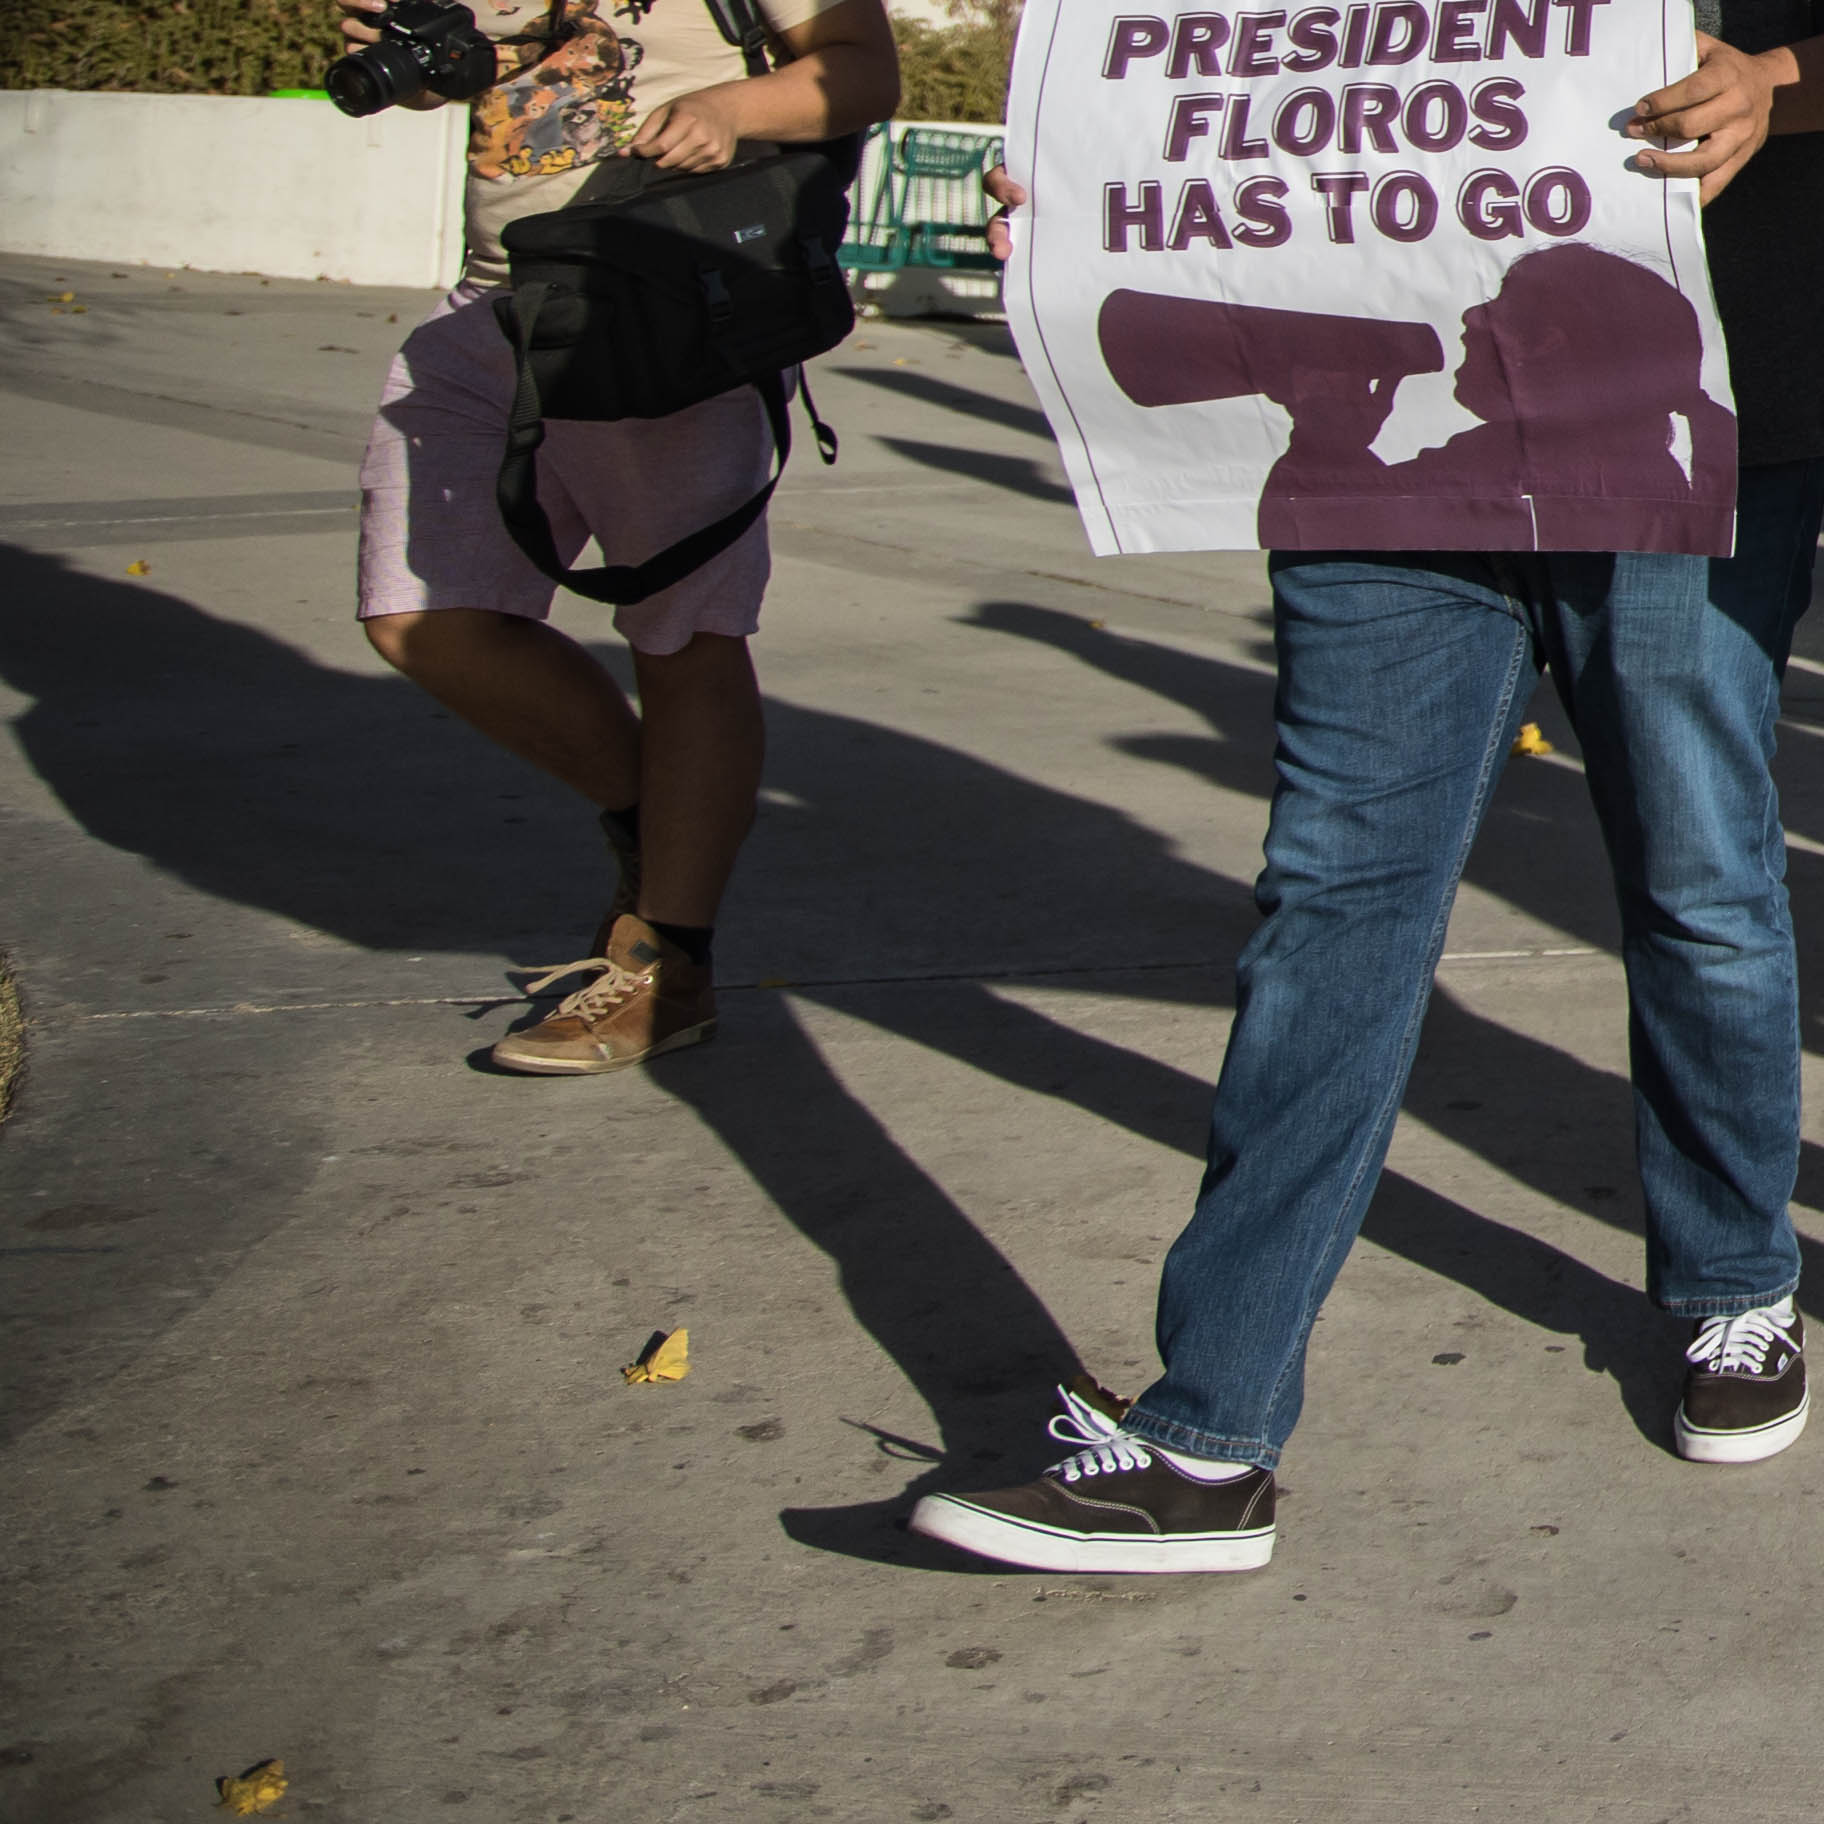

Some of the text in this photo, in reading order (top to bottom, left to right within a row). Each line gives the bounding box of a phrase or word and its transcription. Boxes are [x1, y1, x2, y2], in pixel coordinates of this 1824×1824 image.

[1162, 76, 1529, 163] FLOROS
[1102, 165, 1592, 253] HAS TO GO
